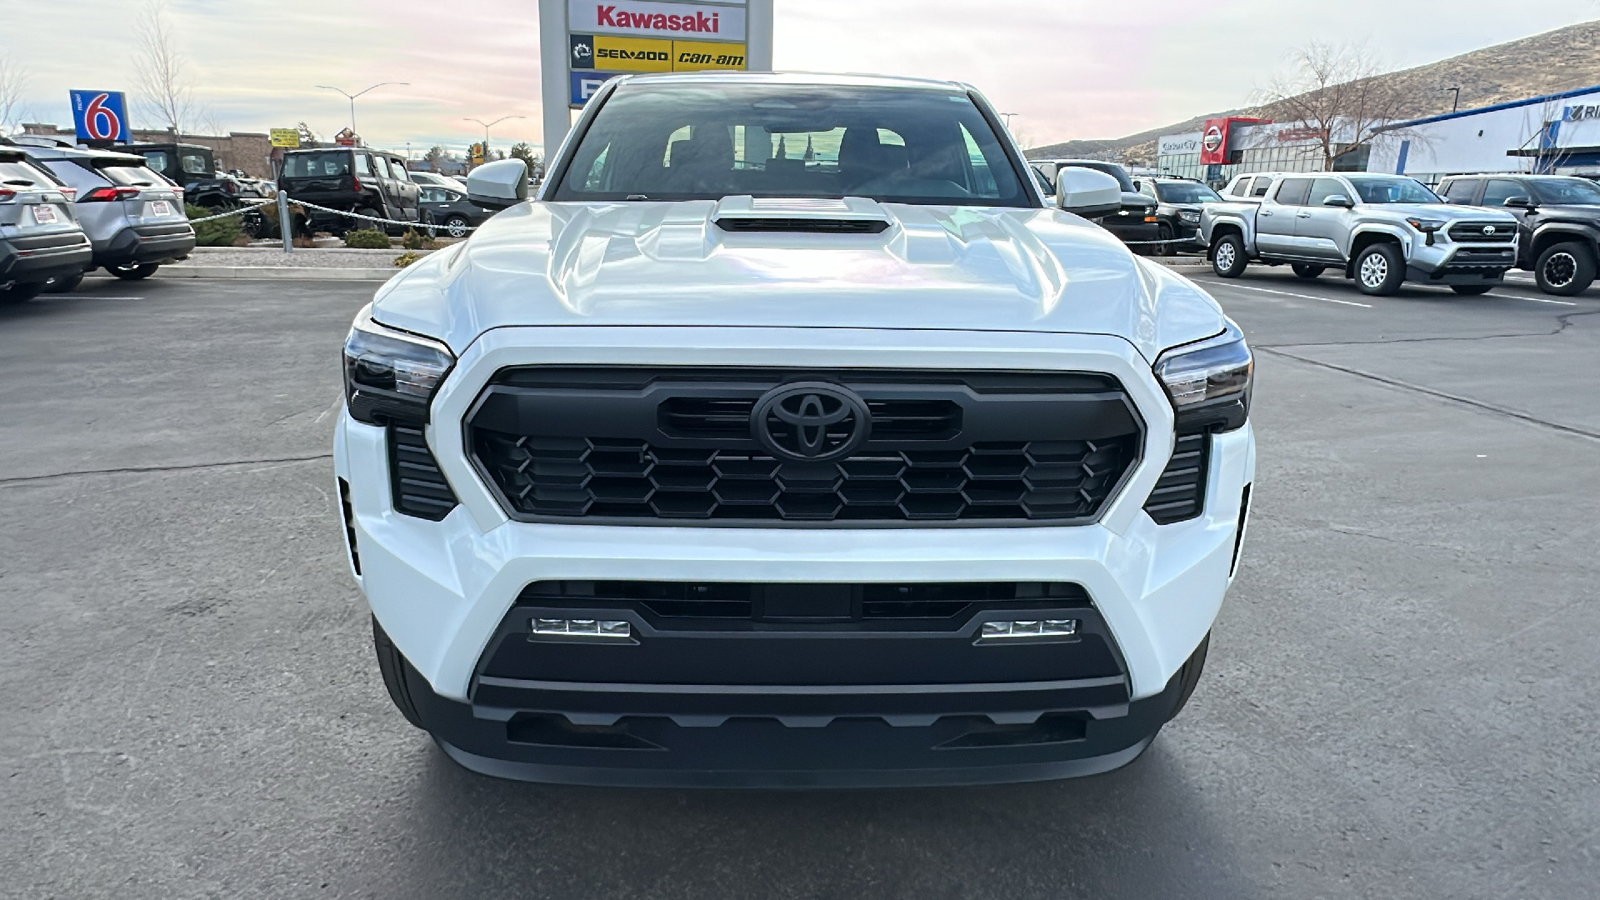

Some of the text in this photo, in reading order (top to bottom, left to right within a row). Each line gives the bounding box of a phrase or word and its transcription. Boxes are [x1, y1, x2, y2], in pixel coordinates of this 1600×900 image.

[597, 5, 719, 33] Kawasaki
[85, 93, 120, 140] 6
[1584, 105, 1600, 118] RI
